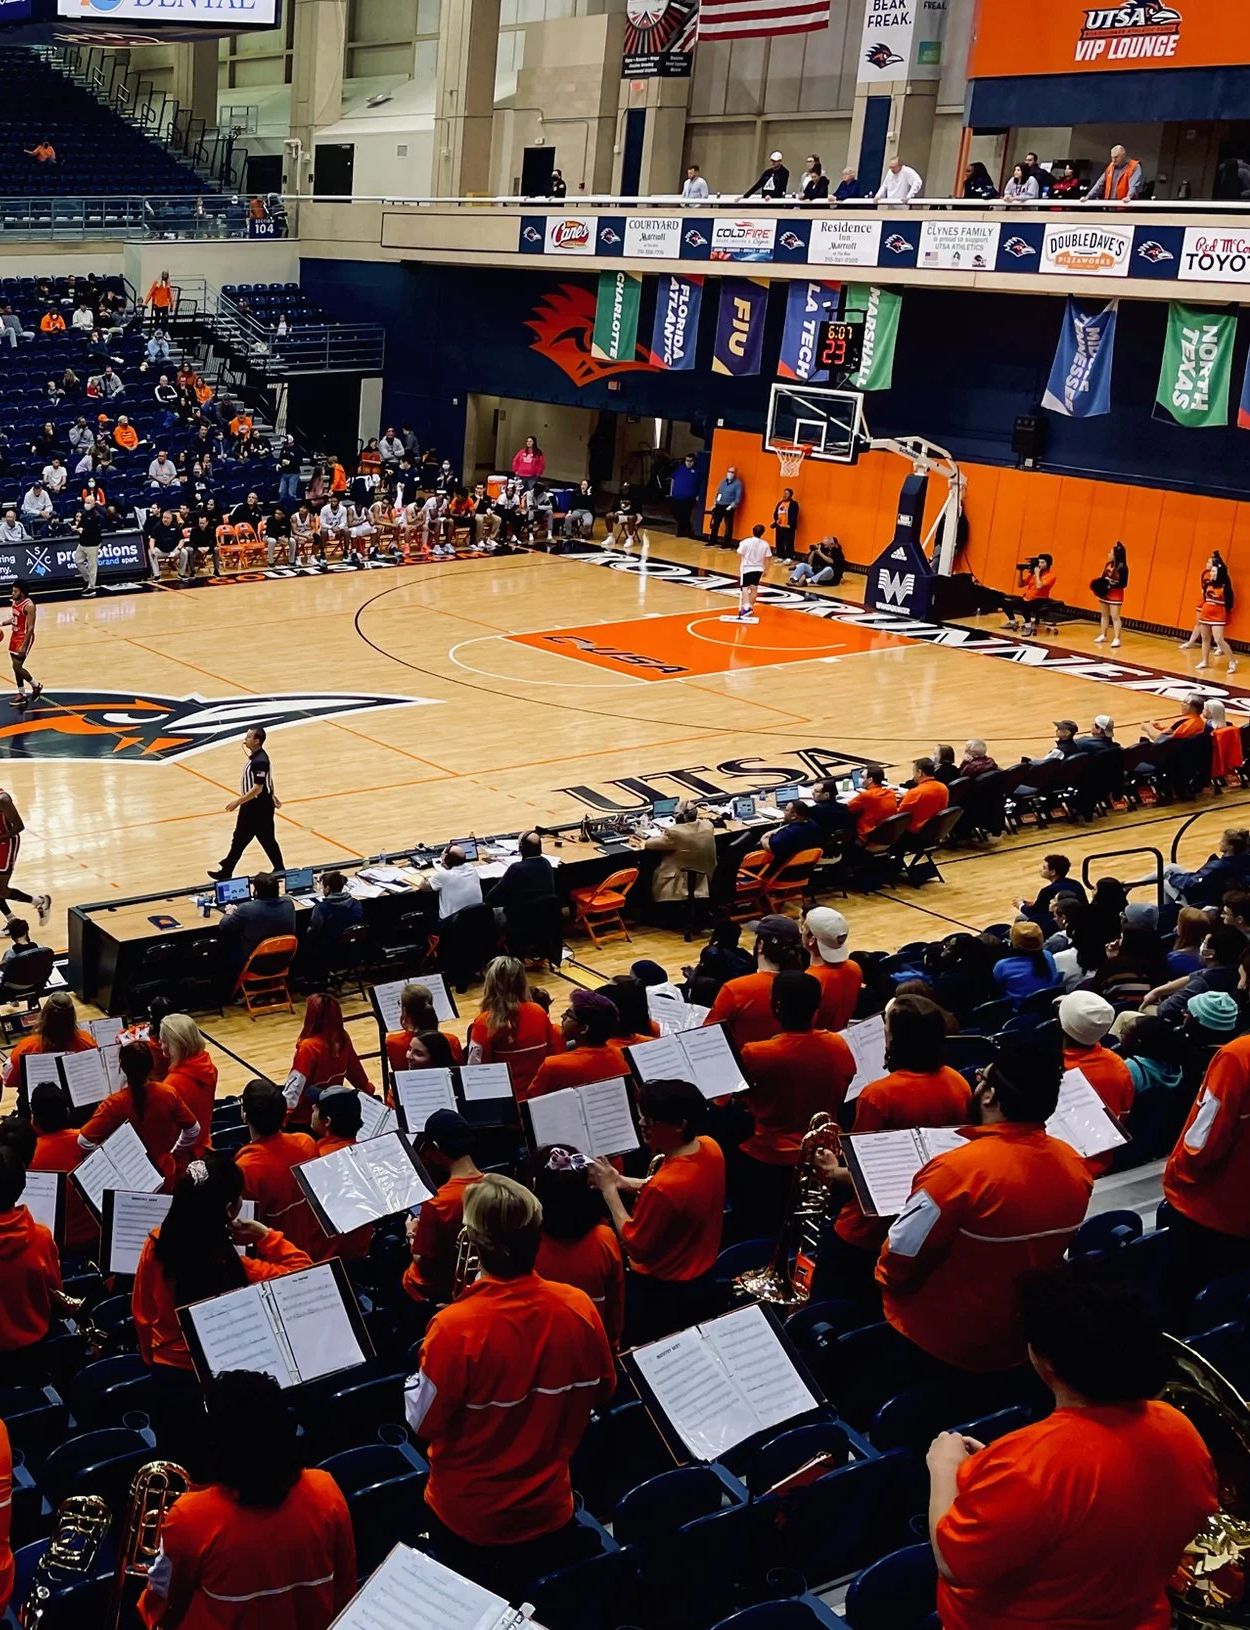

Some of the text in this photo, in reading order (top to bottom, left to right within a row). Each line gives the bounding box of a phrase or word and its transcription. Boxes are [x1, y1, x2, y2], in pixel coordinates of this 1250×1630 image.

[867, 12, 912, 28] FREAK.
[1086, 7, 1146, 29] UTSA
[1075, 34, 1180, 61] VIP LOUNGE
[255, 224, 274, 234] 104
[629, 220, 679, 230] COURTYARD
[716, 228, 770, 238] COLDFIRE
[821, 221, 872, 233] Residence
[927, 226, 994, 237] CLYNES FAMILY
[1196, 237, 1218, 254] Red
[1186, 253, 1250, 272] TOYO
[609, 272, 625, 359] CHARLOTTE
[663, 276, 680, 366] ATLANTIC
[673, 283, 691, 360] FLORIDA
[729, 297, 751, 357] FIU
[796, 283, 821, 379] LA TECH
[828, 325, 853, 340] 6:07
[856, 286, 881, 387] MARSHALL
[822, 340, 846, 364] 23
[1173, 327, 1200, 410] TEXAS
[1191, 325, 1219, 411] NORTH
[26, 556, 52, 566] A C
[34, 546, 41, 555] S
[551, 748, 899, 813] UTSA
